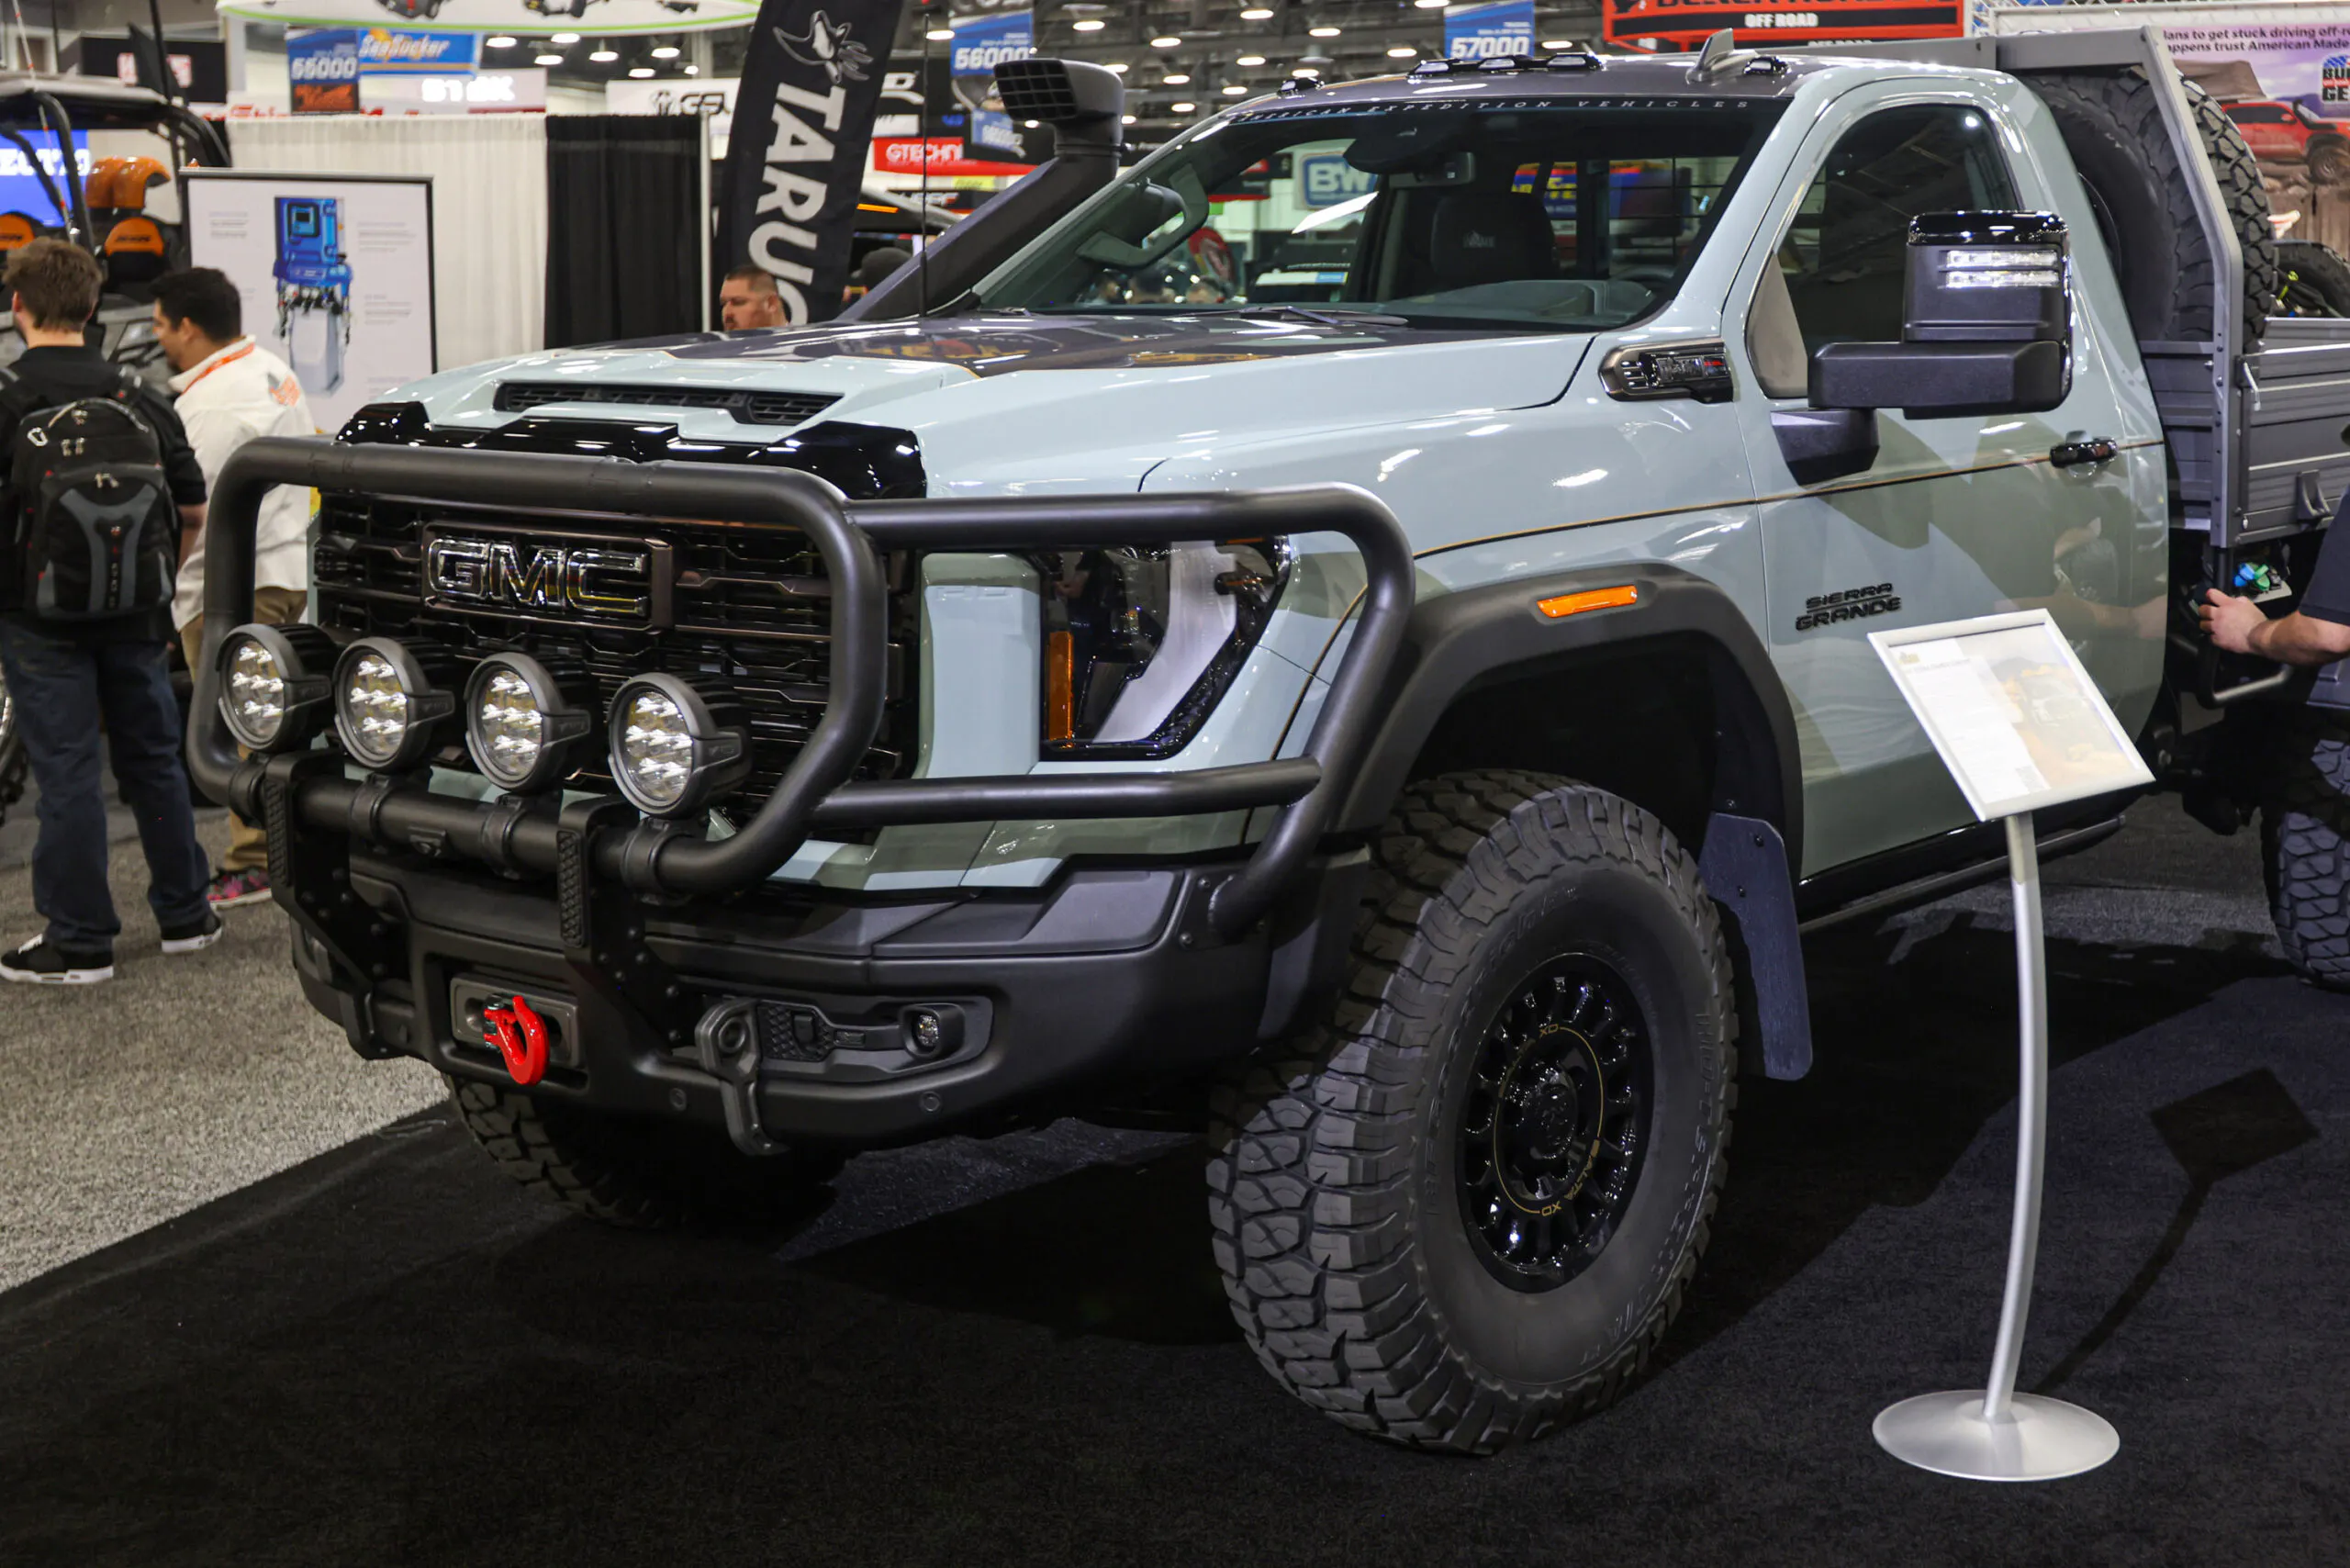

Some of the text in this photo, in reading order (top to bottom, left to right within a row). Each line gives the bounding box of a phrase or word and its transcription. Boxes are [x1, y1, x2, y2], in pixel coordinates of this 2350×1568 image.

[1744, 13, 1818, 28] OFF ROAD
[2192, 29, 2206, 39] to
[2208, 28, 2229, 42] get
[2232, 28, 2266, 39] stuck
[2270, 26, 2315, 39] driving
[1450, 37, 1530, 60] 57000
[2214, 41, 2245, 52] trust
[2248, 39, 2311, 52] American
[2313, 39, 2350, 50] Made
[1366, 100, 1551, 112] EXPEDITION
[1578, 100, 1748, 108] VEHICLES
[428, 538, 648, 613] GMC
[1806, 583, 1893, 610] SIERRA
[1796, 596, 1901, 631] GRANDE
[1542, 1200, 1562, 1217] XD
